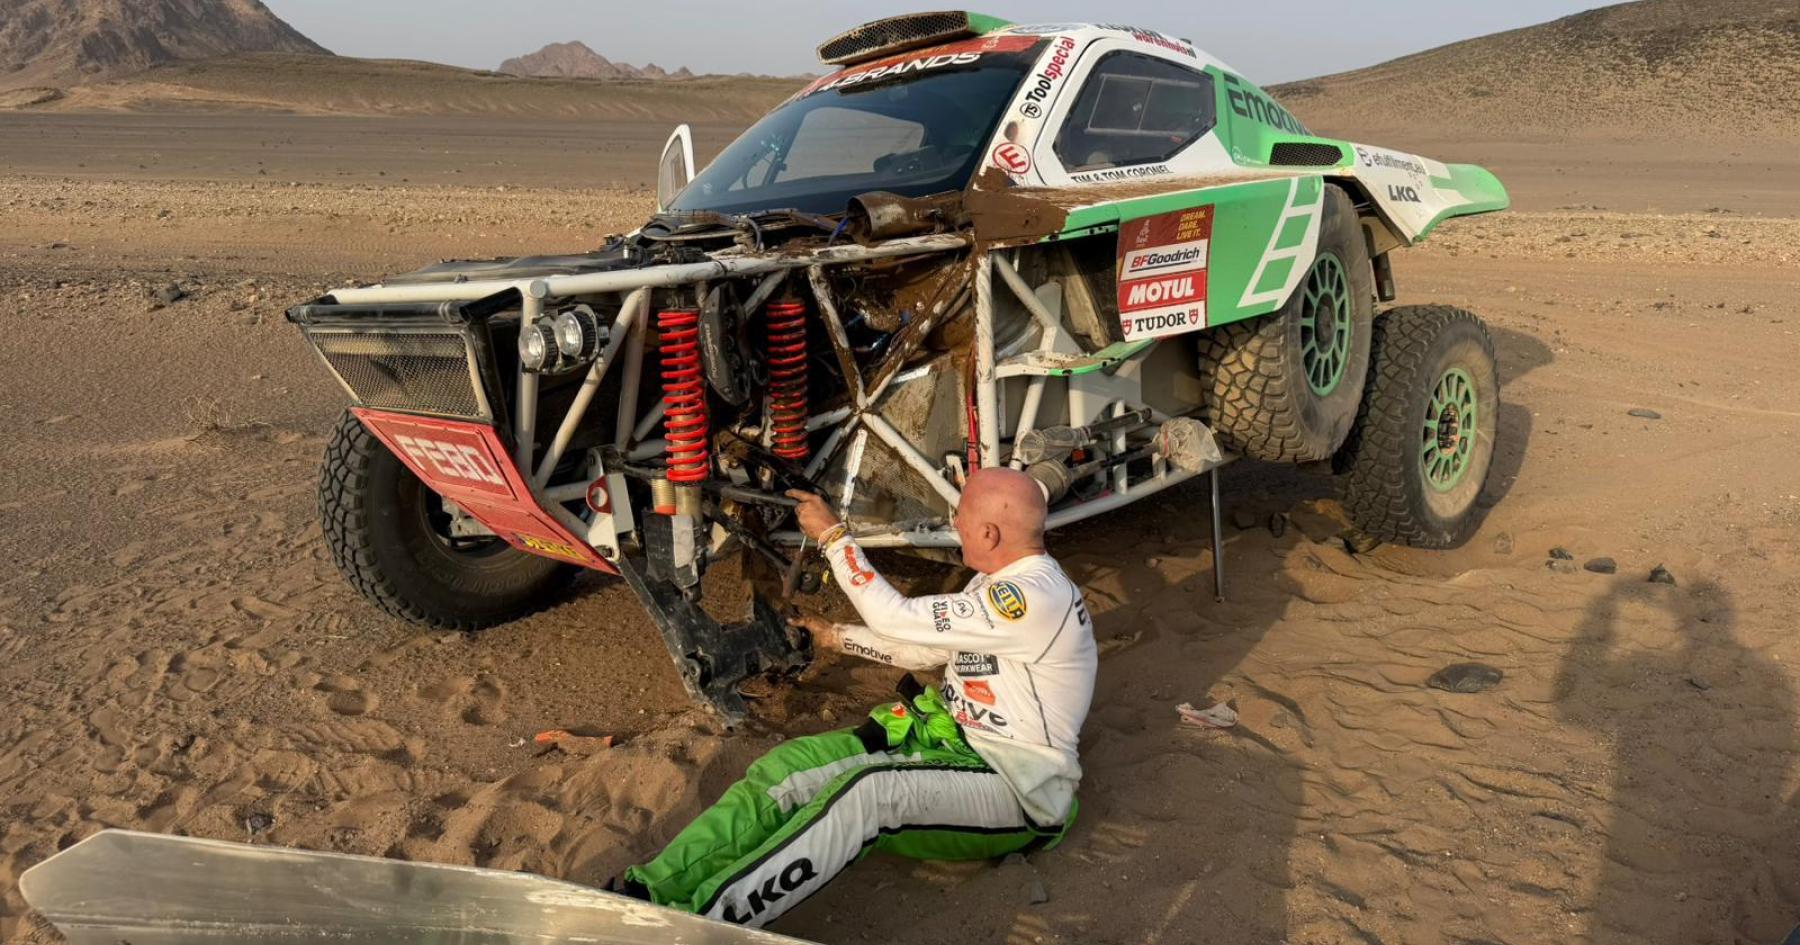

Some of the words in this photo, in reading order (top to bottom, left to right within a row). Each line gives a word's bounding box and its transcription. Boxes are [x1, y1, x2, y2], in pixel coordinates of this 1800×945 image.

[1026, 36, 1076, 102] Toolspecial
[1388, 184, 1421, 203] LKQ
[1131, 247, 1200, 268] BFGoodrich
[1127, 277, 1195, 305] MOTUL
[1135, 312, 1187, 332] TUDOR
[394, 434, 504, 486] FEBO
[932, 602, 944, 632] GUARD
[843, 637, 892, 664] Emotive
[957, 653, 985, 664] ASCOT
[955, 664, 993, 673] RKWEAR
[722, 858, 819, 925] LKQ
